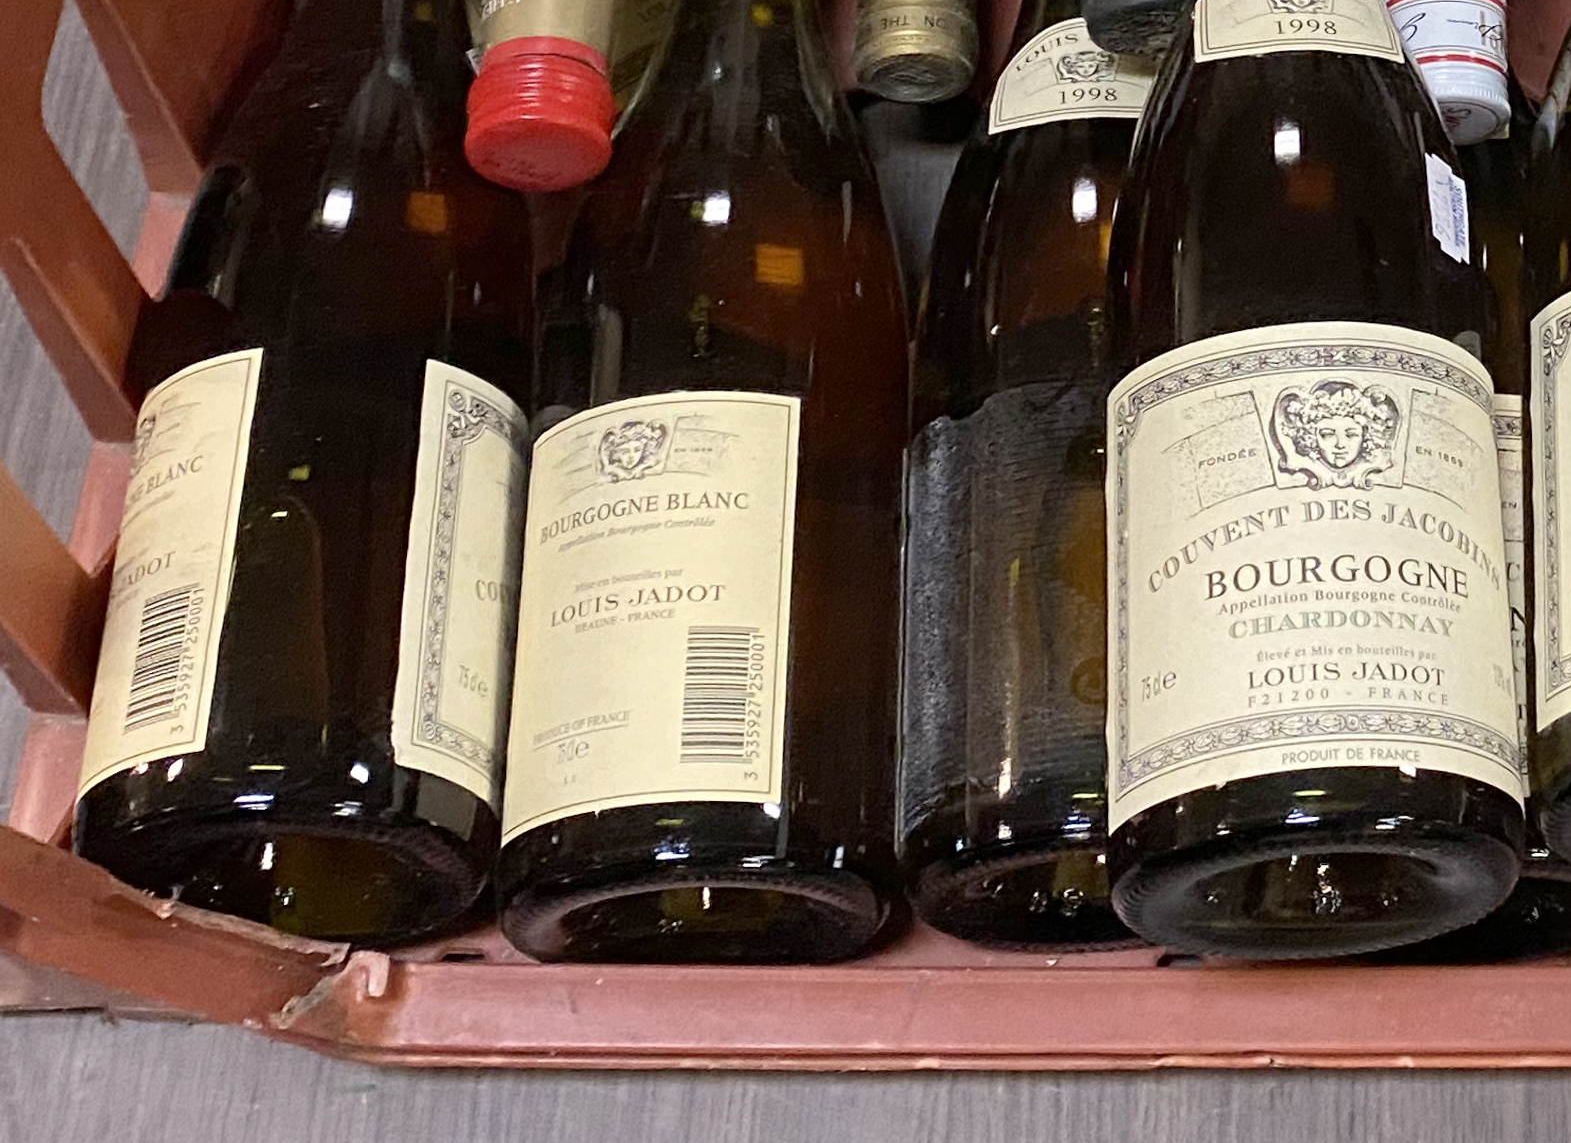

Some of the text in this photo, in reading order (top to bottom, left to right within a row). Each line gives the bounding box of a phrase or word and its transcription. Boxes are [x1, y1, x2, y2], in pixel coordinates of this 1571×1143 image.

[1275, 18, 1339, 36] 1998
[1016, 32, 1078, 73] LOUIS
[1058, 88, 1118, 105] 1998
[1198, 447, 1258, 469] FONDÉE
[1415, 445, 1433, 456] EN
[144, 454, 205, 492] BLANC
[539, 492, 750, 545] BOURGOGNE BLANC
[607, 519, 662, 539] Bourgogne
[1147, 504, 1291, 595] COUVENT
[1302, 499, 1372, 523] DES
[1204, 554, 1470, 602] BOURGOGNE
[185, 586, 205, 646] 250001
[550, 584, 726, 628] LOUIS JADOT
[627, 608, 676, 624] FRANCE
[1217, 588, 1462, 616] Appellation Bourgogne Contrôlée
[1227, 608, 1454, 640] CHARDONNAY
[749, 632, 766, 693] 250001
[1310, 645, 1335, 657] Mis
[1355, 644, 1416, 658] bouteilles
[1418, 650, 1437, 662] par
[1248, 662, 1446, 690] LOUIS JADOT
[1367, 686, 1451, 707] FRANCE
[746, 700, 764, 760] 535927
[1281, 747, 1422, 765] PRODUIT DE FRANCE
